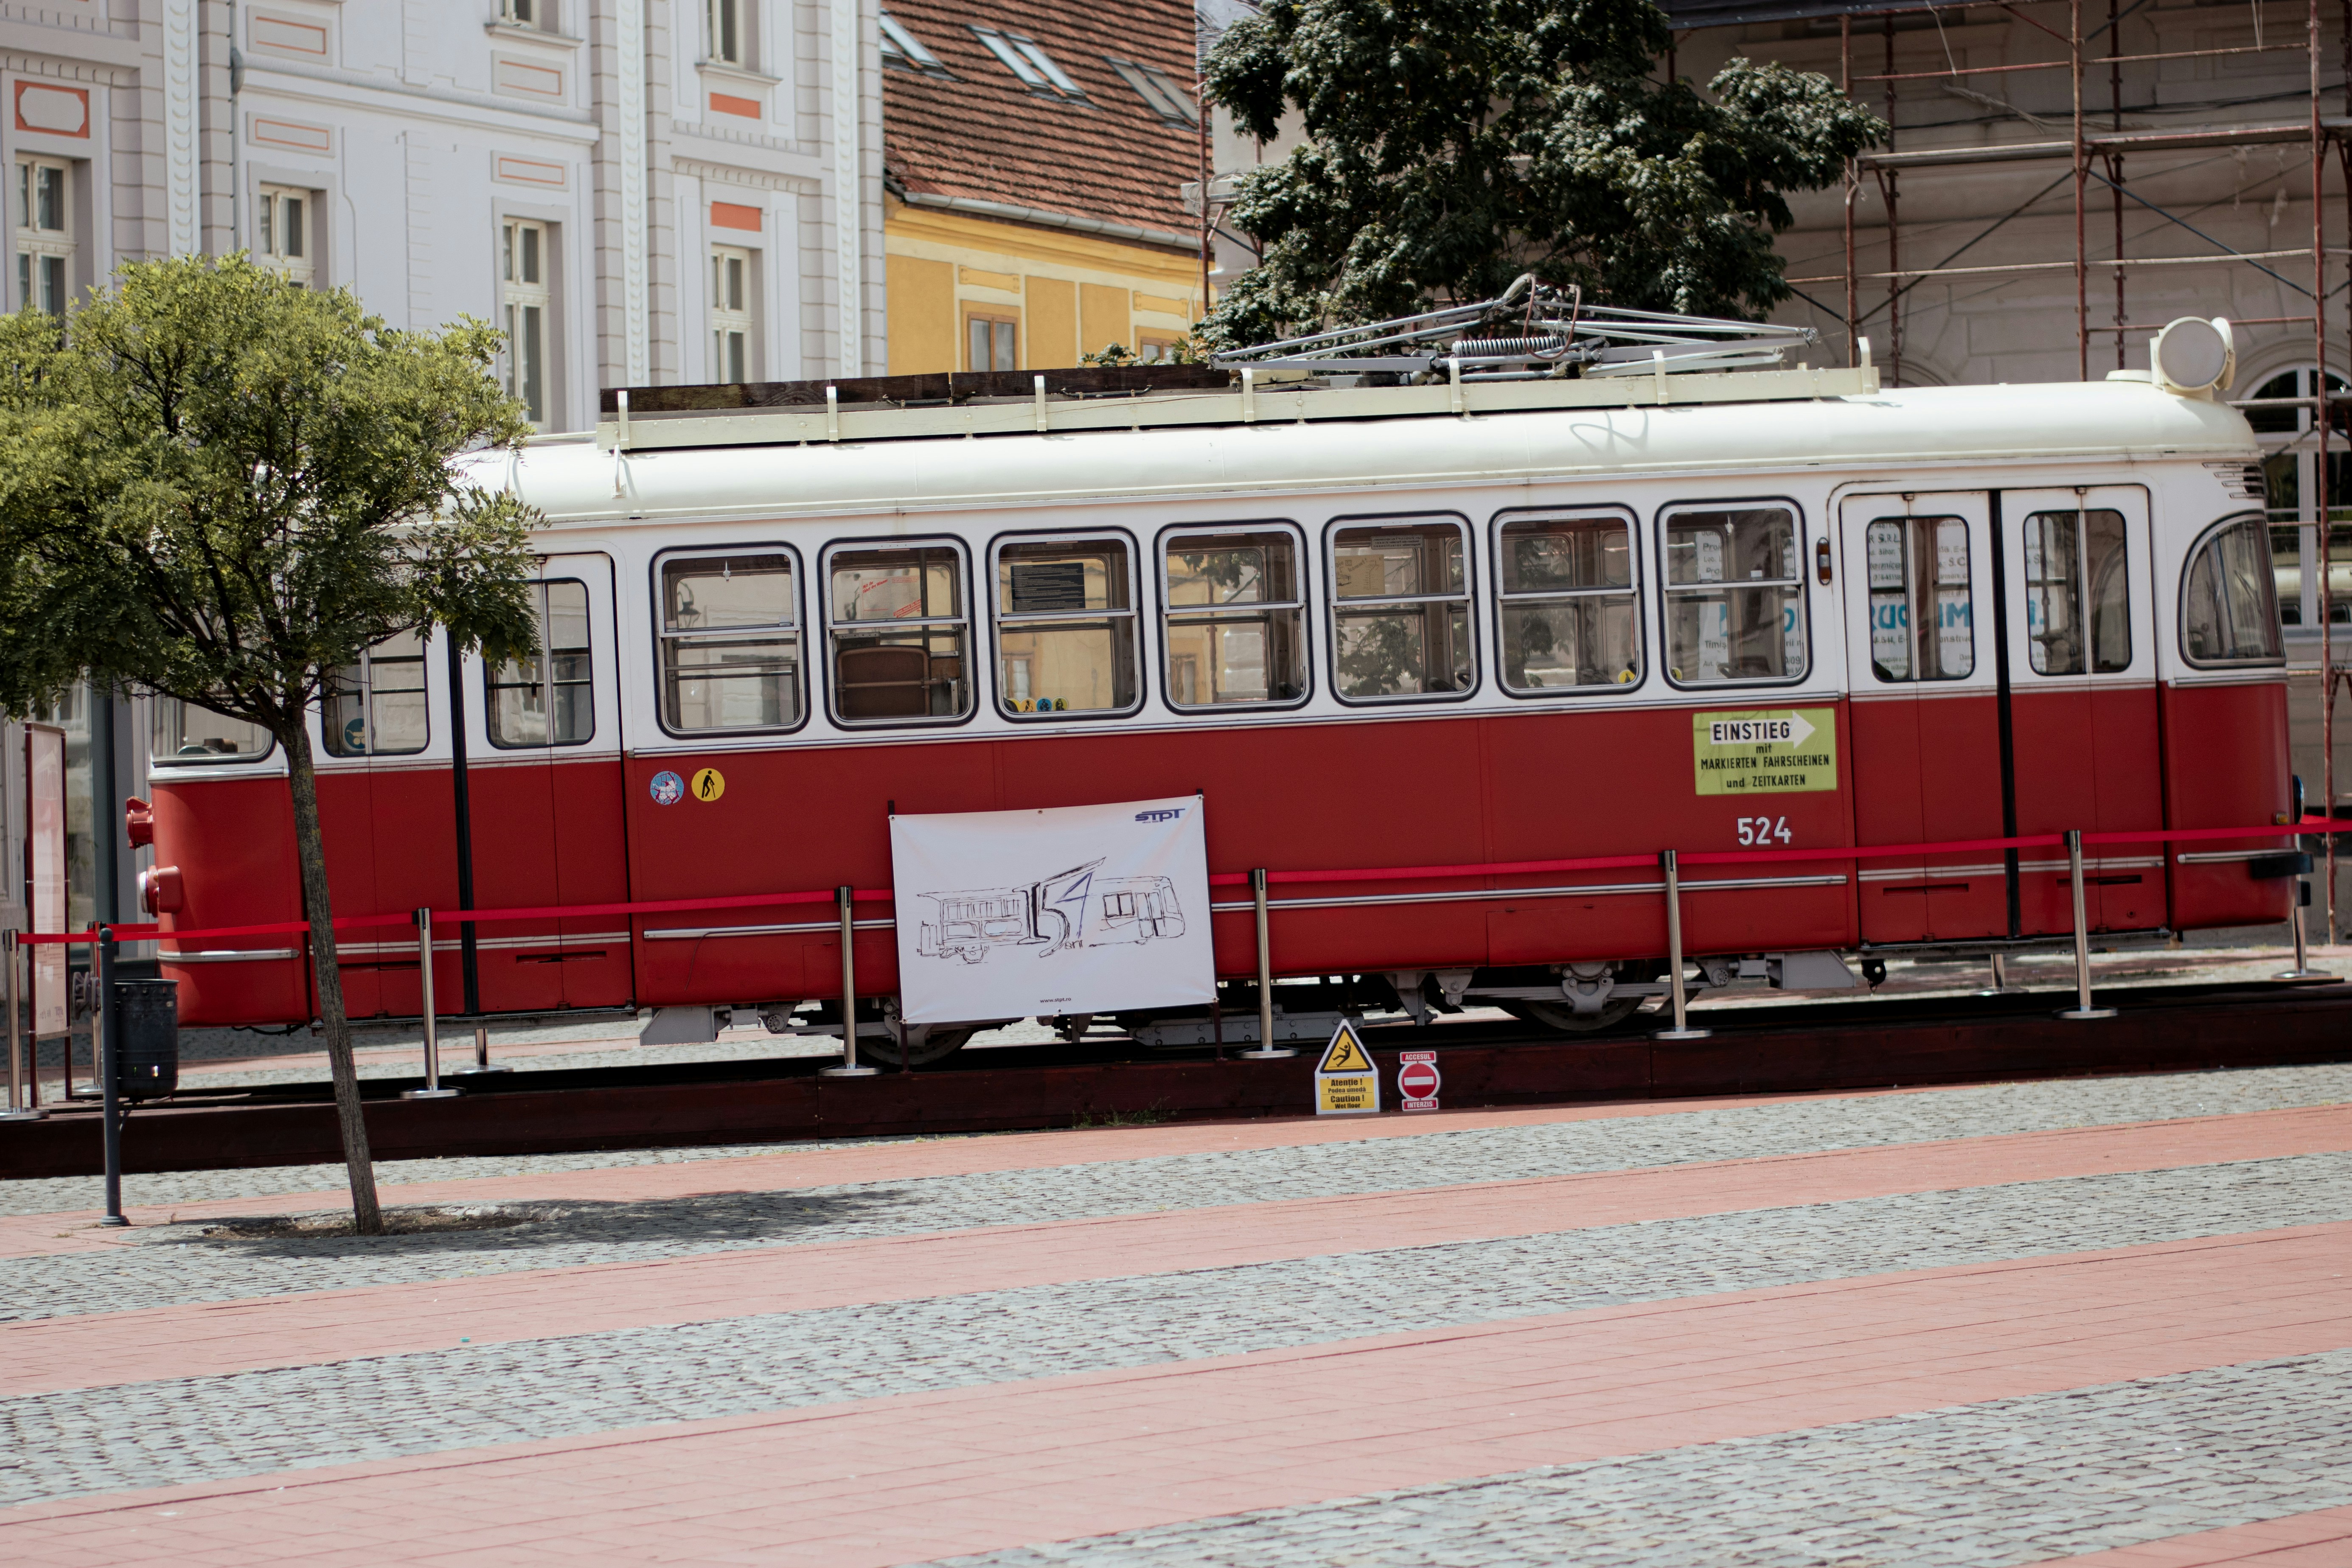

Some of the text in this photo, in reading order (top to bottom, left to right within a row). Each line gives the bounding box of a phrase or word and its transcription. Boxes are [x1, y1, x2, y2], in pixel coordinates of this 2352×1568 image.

[1713, 721, 1790, 741] EINSTIEG
[1756, 744, 1772, 754] mit
[1701, 754, 1829, 770] MARKIERTEN FAHRSCHEINEN
[1726, 774, 1805, 788] und ZEITKARTEN
[1737, 816, 1792, 846] 524
